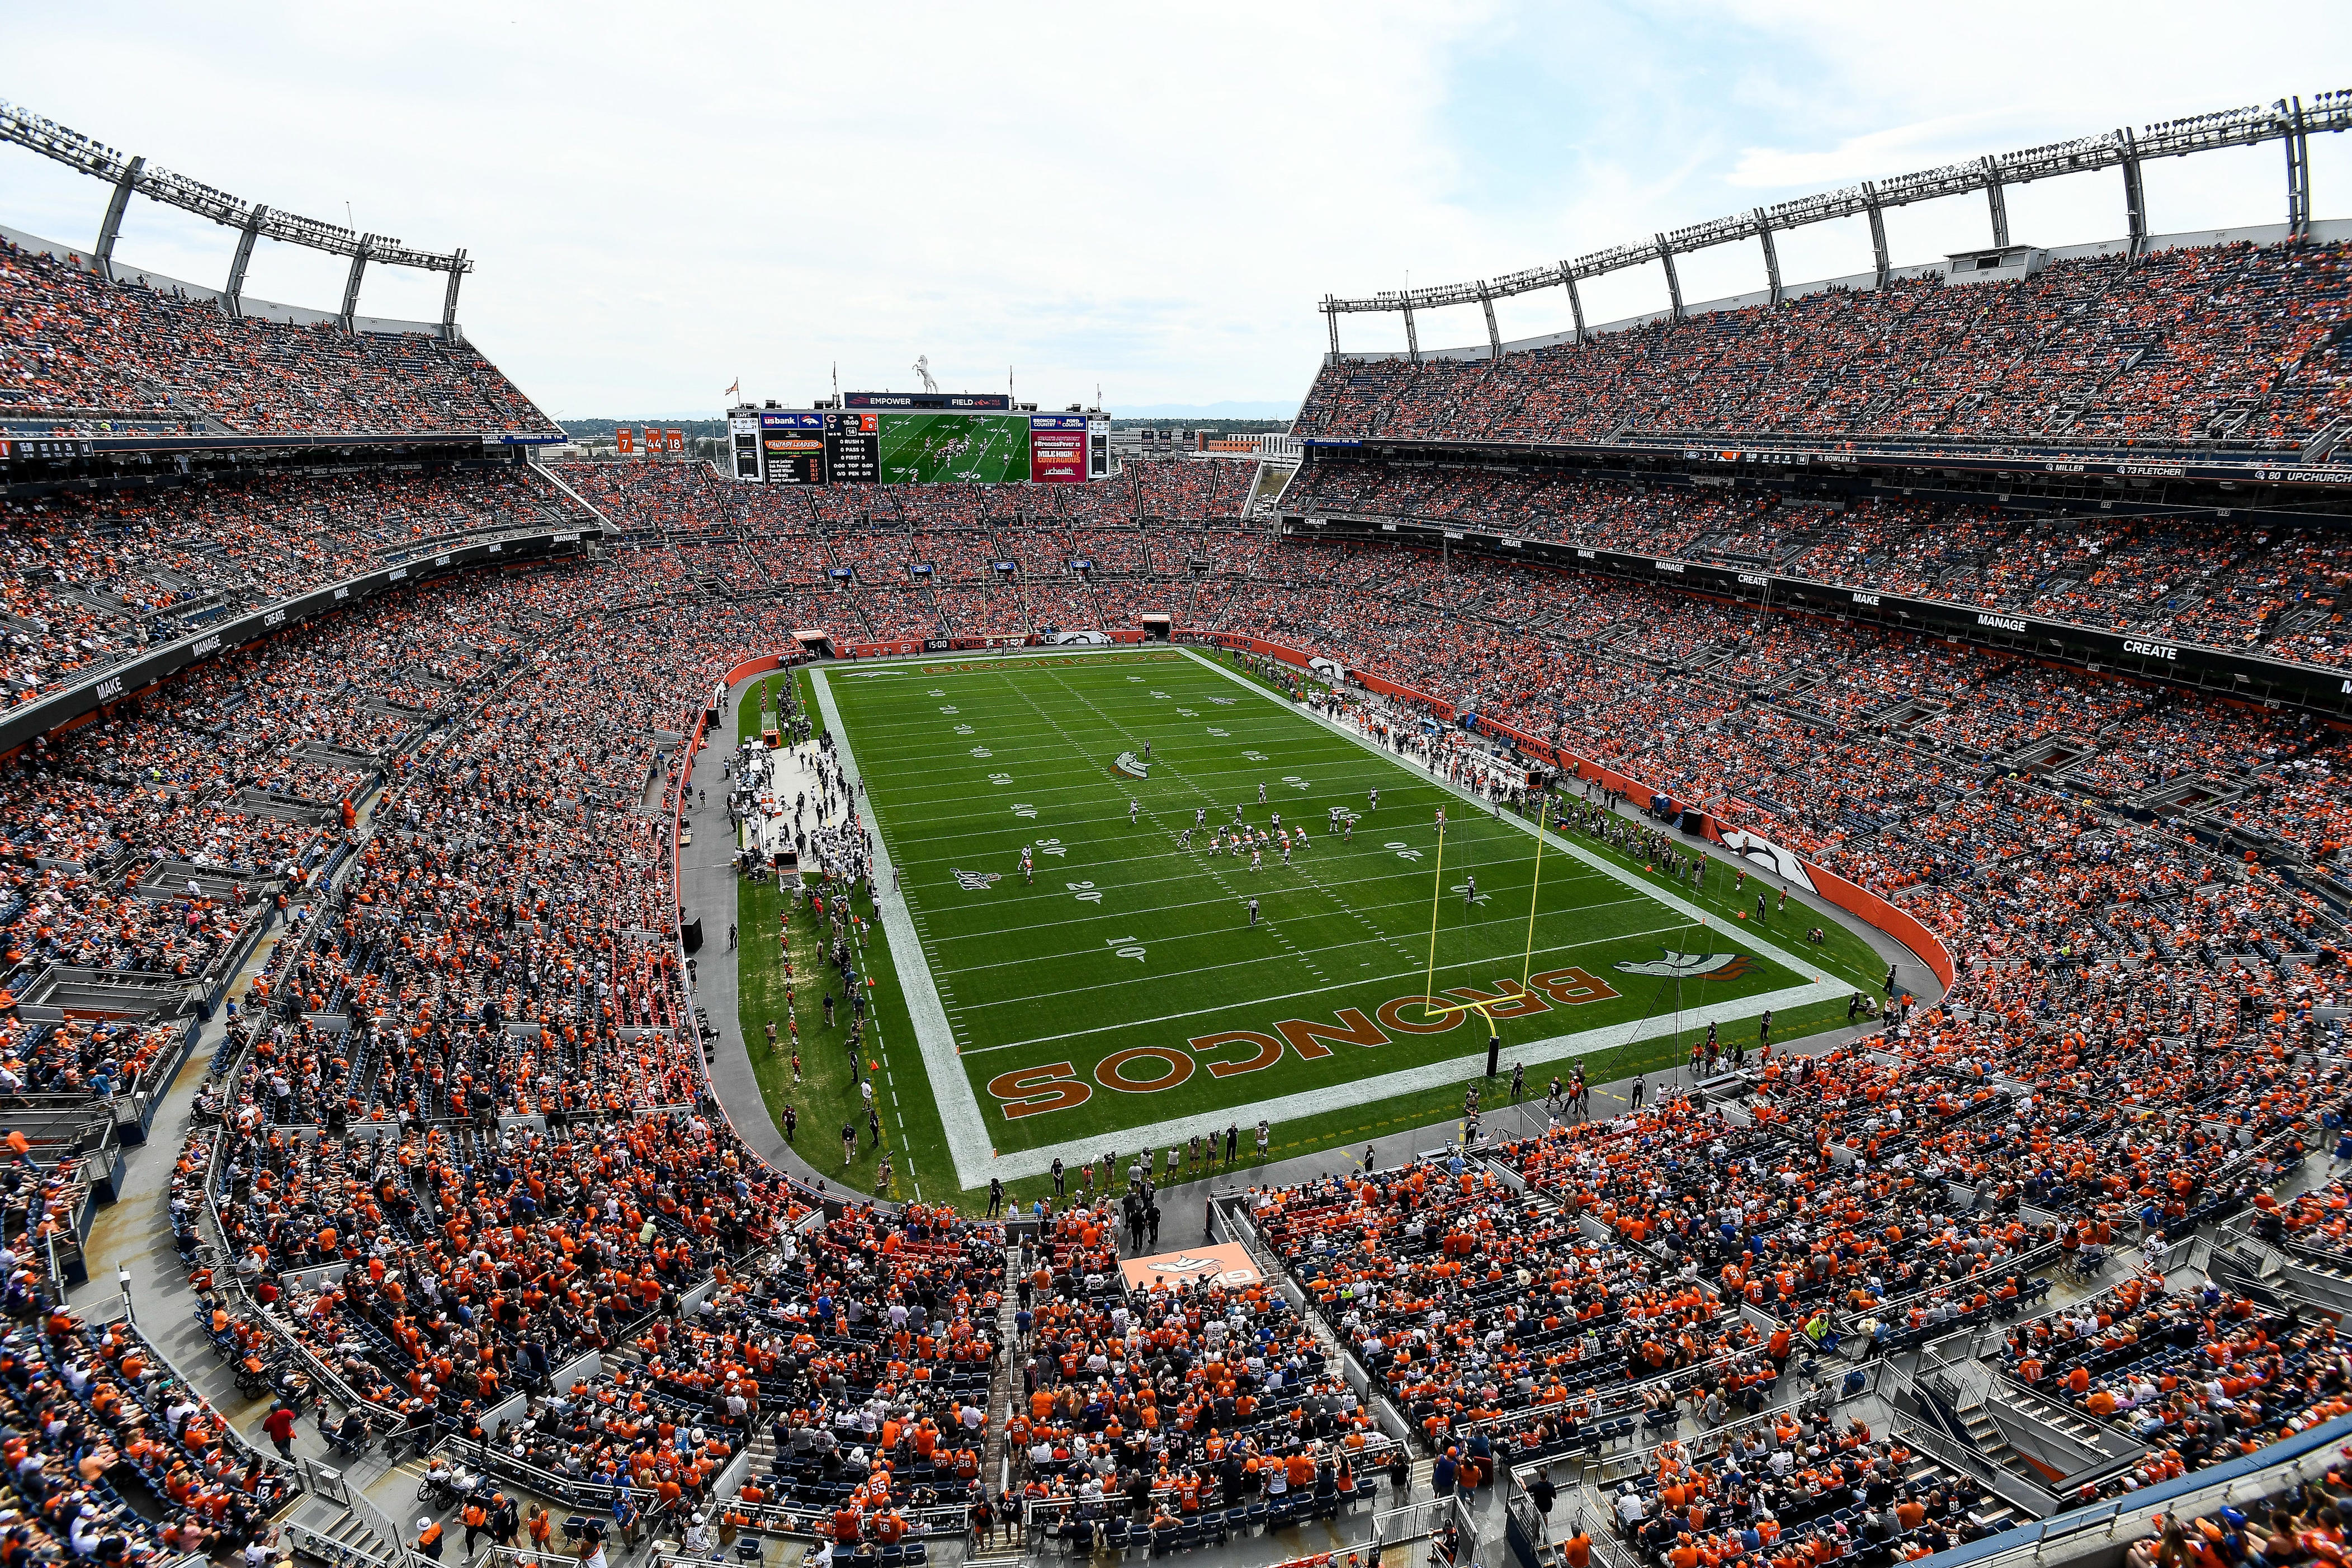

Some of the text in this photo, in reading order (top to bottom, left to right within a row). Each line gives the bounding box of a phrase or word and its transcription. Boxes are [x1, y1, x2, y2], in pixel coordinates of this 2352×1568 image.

[621, 439, 628, 449] 7
[648, 439, 661, 449] 44
[669, 439, 681, 449] 18
[2137, 467, 2181, 476] FLETCHER
[2268, 471, 2281, 480] 80
[554, 533, 580, 542] MANAGE
[1501, 539, 1522, 547] CREATE
[489, 544, 501, 552] MAKE
[1578, 550, 1595, 559] MAKE
[436, 555, 450, 566] CREATE
[1655, 561, 1684, 573] MANAGE
[389, 568, 407, 582] MANAGE
[1737, 574, 1768, 586] CREATE
[334, 587, 349, 599] MAKE
[1852, 593, 1879, 606] MAKE
[264, 609, 286, 626] CREATE
[1977, 614, 2027, 632] MANAGE
[192, 634, 221, 657] MANAGE
[2123, 640, 2178, 659] CREATE
[921, 653, 1183, 674] BRONCOS
[96, 676, 122, 700] MAKE
[1150, 691, 1172, 699] 20
[939, 706, 960, 714] 20
[1441, 705, 1451, 715] OF
[2265, 700, 2279, 709] 109
[1177, 708, 1199, 717] 30
[953, 725, 975, 734] 30
[1207, 728, 1231, 737] 40
[970, 748, 993, 758] 40
[1241, 750, 1269, 761] 50
[988, 773, 1013, 785] 50
[1281, 777, 1311, 787] 40
[1010, 803, 1037, 816] 40
[1036, 839, 1067, 854] 30
[1383, 842, 1423, 858] 20
[1065, 881, 1102, 900] 20
[1106, 936, 1146, 958] 10
[986, 964, 1624, 1121] BRONCOS
[824, 1410, 833, 1419] 52
[1170, 1439, 1182, 1449] 54
[1194, 1447, 1205, 1461] 52
[1213, 1448, 1221, 1460] 7
[871, 1480, 886, 1495] 55
[1810, 1481, 1820, 1493] 58
[1184, 1491, 1193, 1500] 18
[879, 1523, 890, 1533] 18
